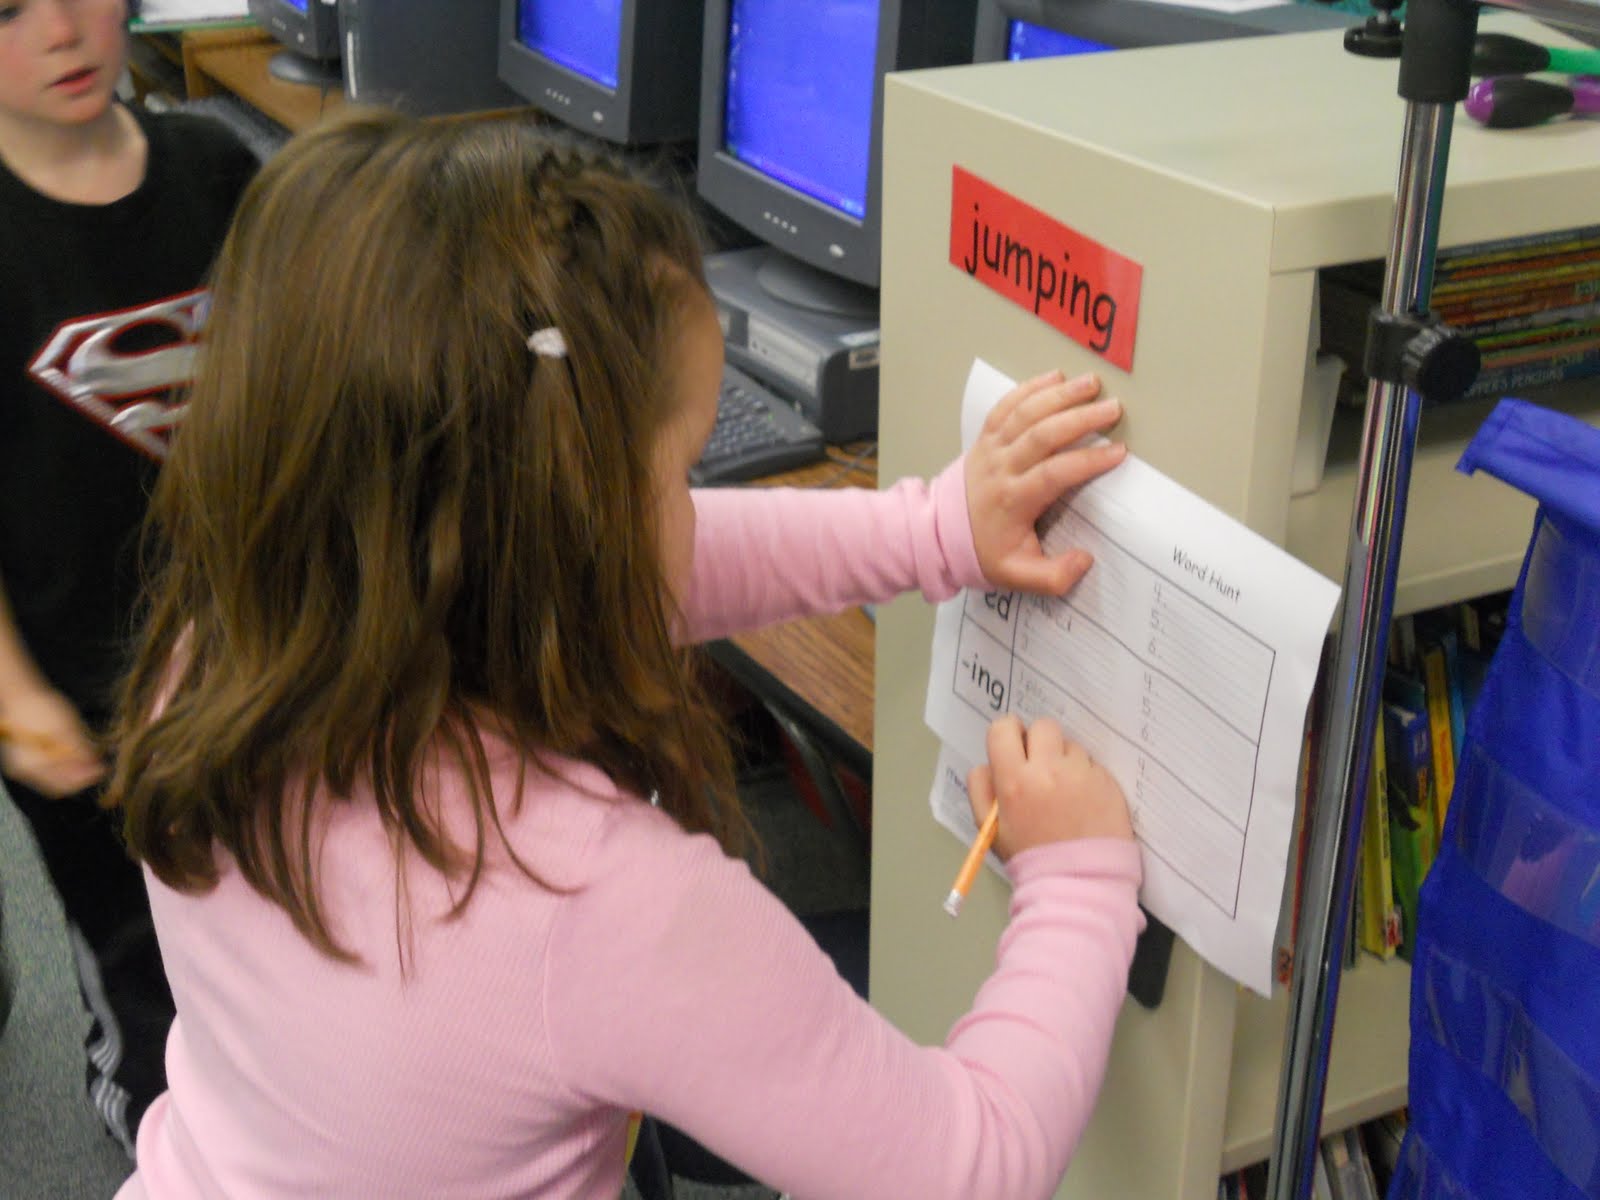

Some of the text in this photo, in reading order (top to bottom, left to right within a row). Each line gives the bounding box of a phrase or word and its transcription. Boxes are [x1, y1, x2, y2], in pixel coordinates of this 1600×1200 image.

[964, 202, 1117, 353] jumping
[1173, 545, 1241, 604] Word Hunt
[962, 652, 1004, 711] -ing
